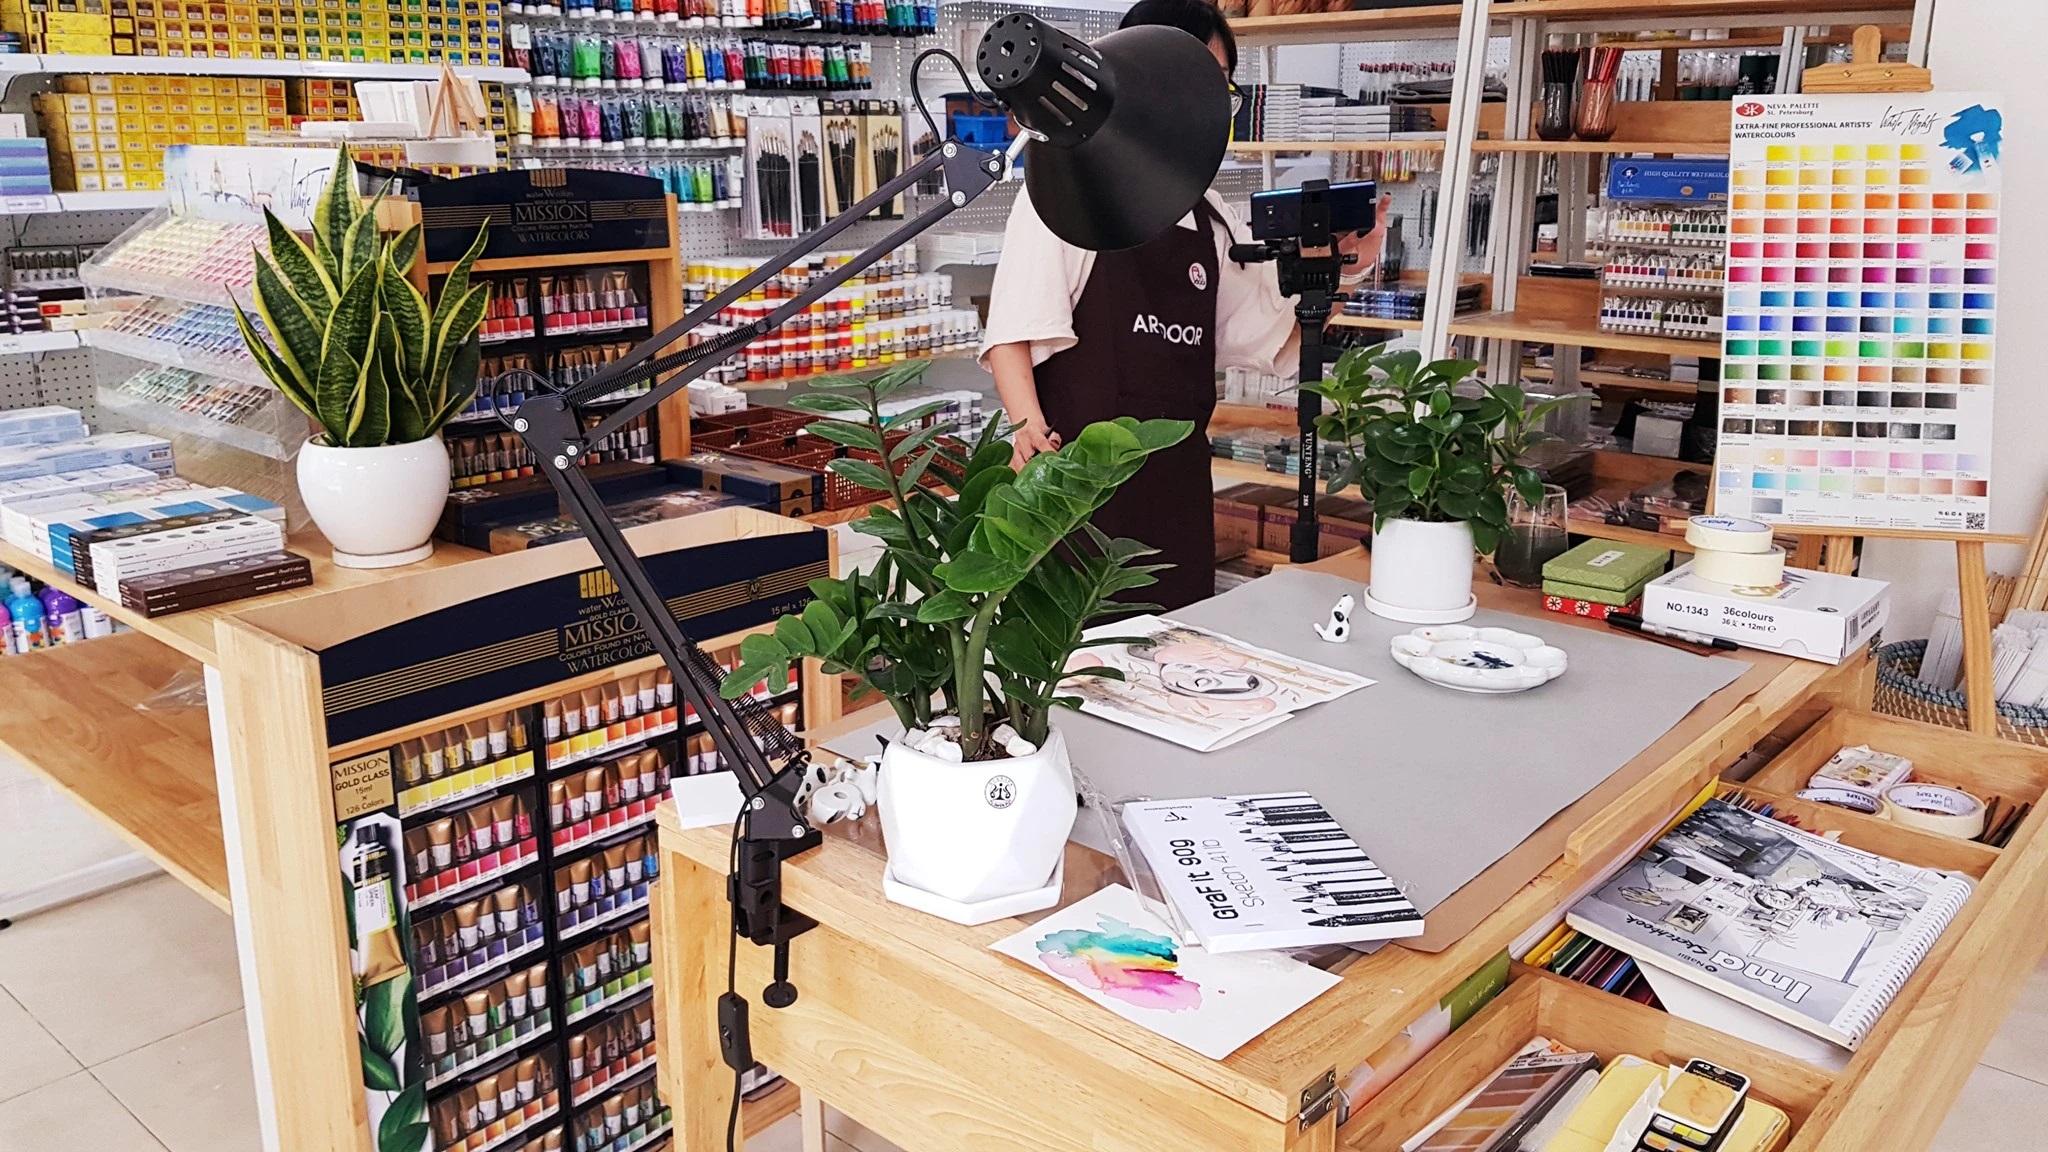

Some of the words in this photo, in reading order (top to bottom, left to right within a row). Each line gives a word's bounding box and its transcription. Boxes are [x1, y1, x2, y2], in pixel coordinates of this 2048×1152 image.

[1780, 122, 1838, 130] PROFESSIONAL
[1901, 111, 1942, 136] Nights
[1735, 131, 1796, 139] WATERCOLOURS
[516, 204, 588, 223] MISSION
[518, 230, 590, 244] WATERCOLORS
[589, 612, 607, 621] GOLD
[608, 606, 630, 616] CLASS
[1666, 601, 1709, 617] NO.1343
[1722, 605, 1775, 623] 36colours
[564, 612, 643, 649] MISSIO
[1747, 623, 1766, 632] 12ml
[567, 641, 656, 673] WATERCOLOR
[335, 756, 388, 779] MISSION
[335, 778, 360, 792] GOLD
[361, 768, 390, 784] CLASS
[355, 784, 373, 795] 15ml
[346, 807, 360, 815] 126
[361, 799, 385, 810] Colors
[1169, 839, 1202, 866] 90g
[1187, 870, 1215, 883] it
[1221, 865, 1265, 908] Sketch
[1626, 913, 1709, 956] Sketchbook
